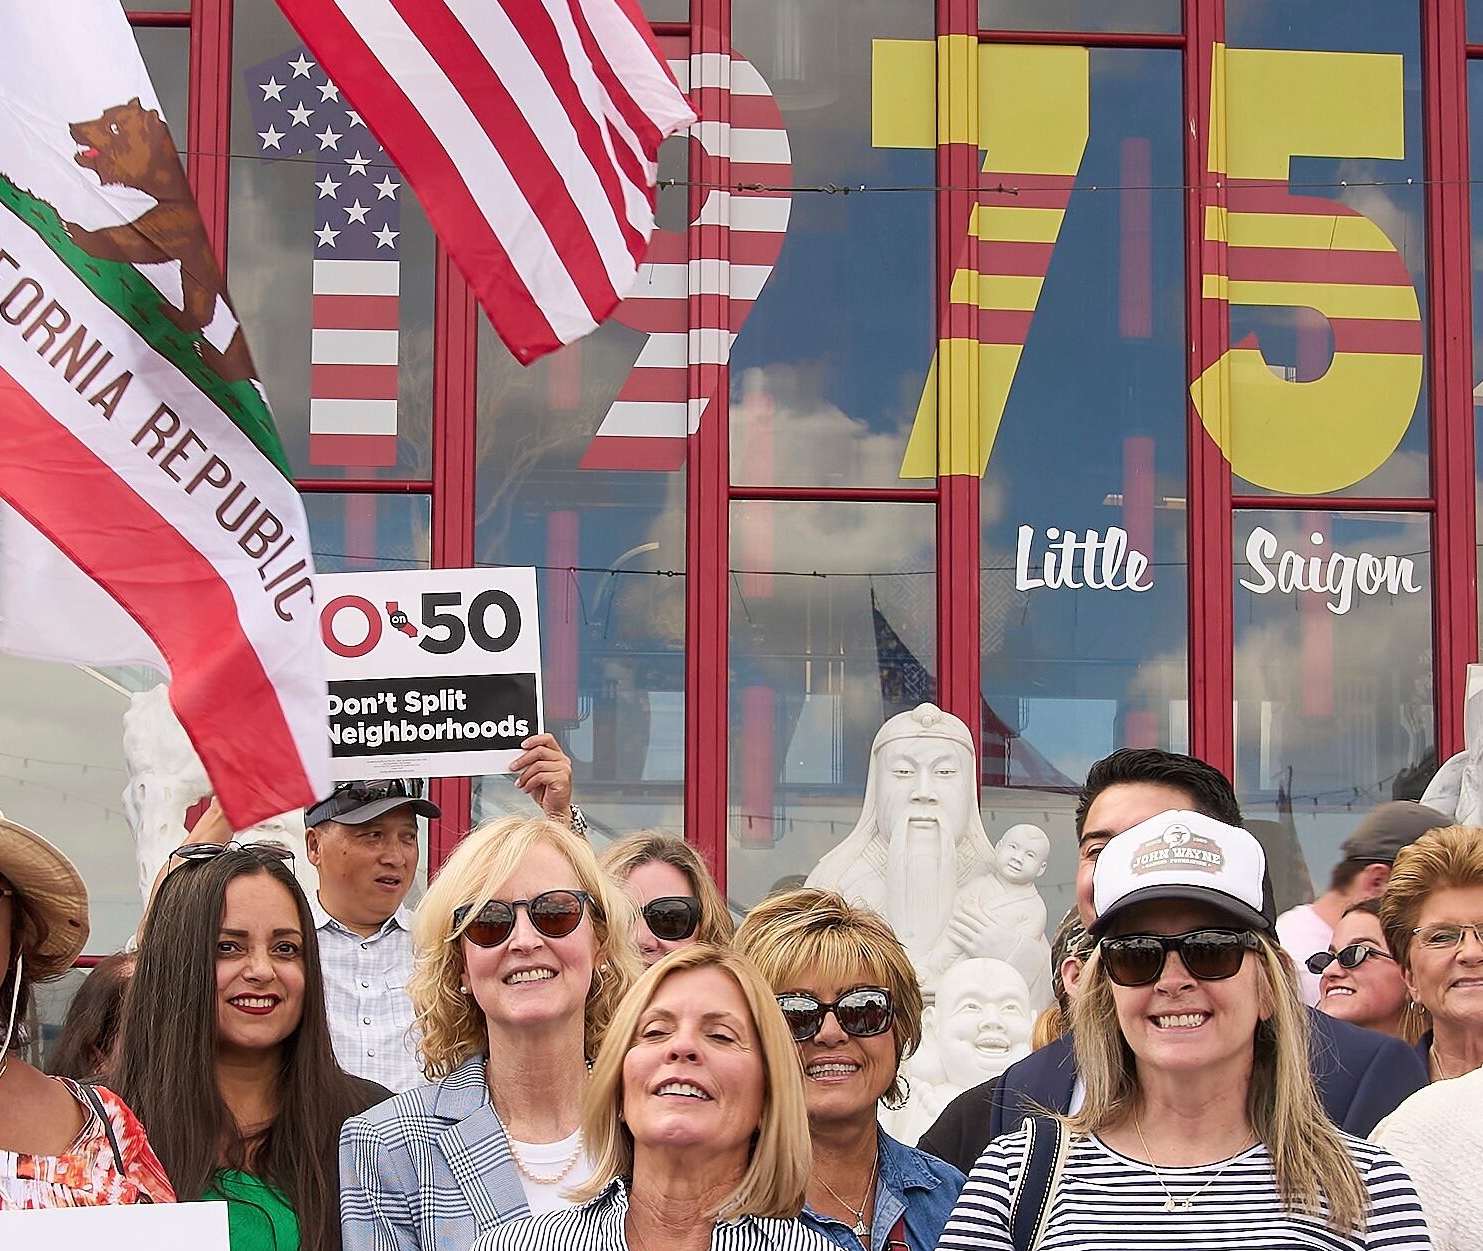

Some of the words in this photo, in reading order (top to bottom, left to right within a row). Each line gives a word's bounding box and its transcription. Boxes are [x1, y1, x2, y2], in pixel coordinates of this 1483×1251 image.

[132, 408, 315, 622] REPUBLIC
[1016, 525, 1154, 592] Little
[1239, 527, 1422, 615] Saigon
[319, 595, 383, 658] O
[392, 615, 406, 625] on
[418, 589, 522, 655] 50
[326, 691, 398, 716] Don't
[404, 688, 467, 721] Split
[327, 715, 529, 748] Neighborhoods
[1132, 848, 1170, 868] JOHN
[1171, 847, 1221, 865] WAYNE
